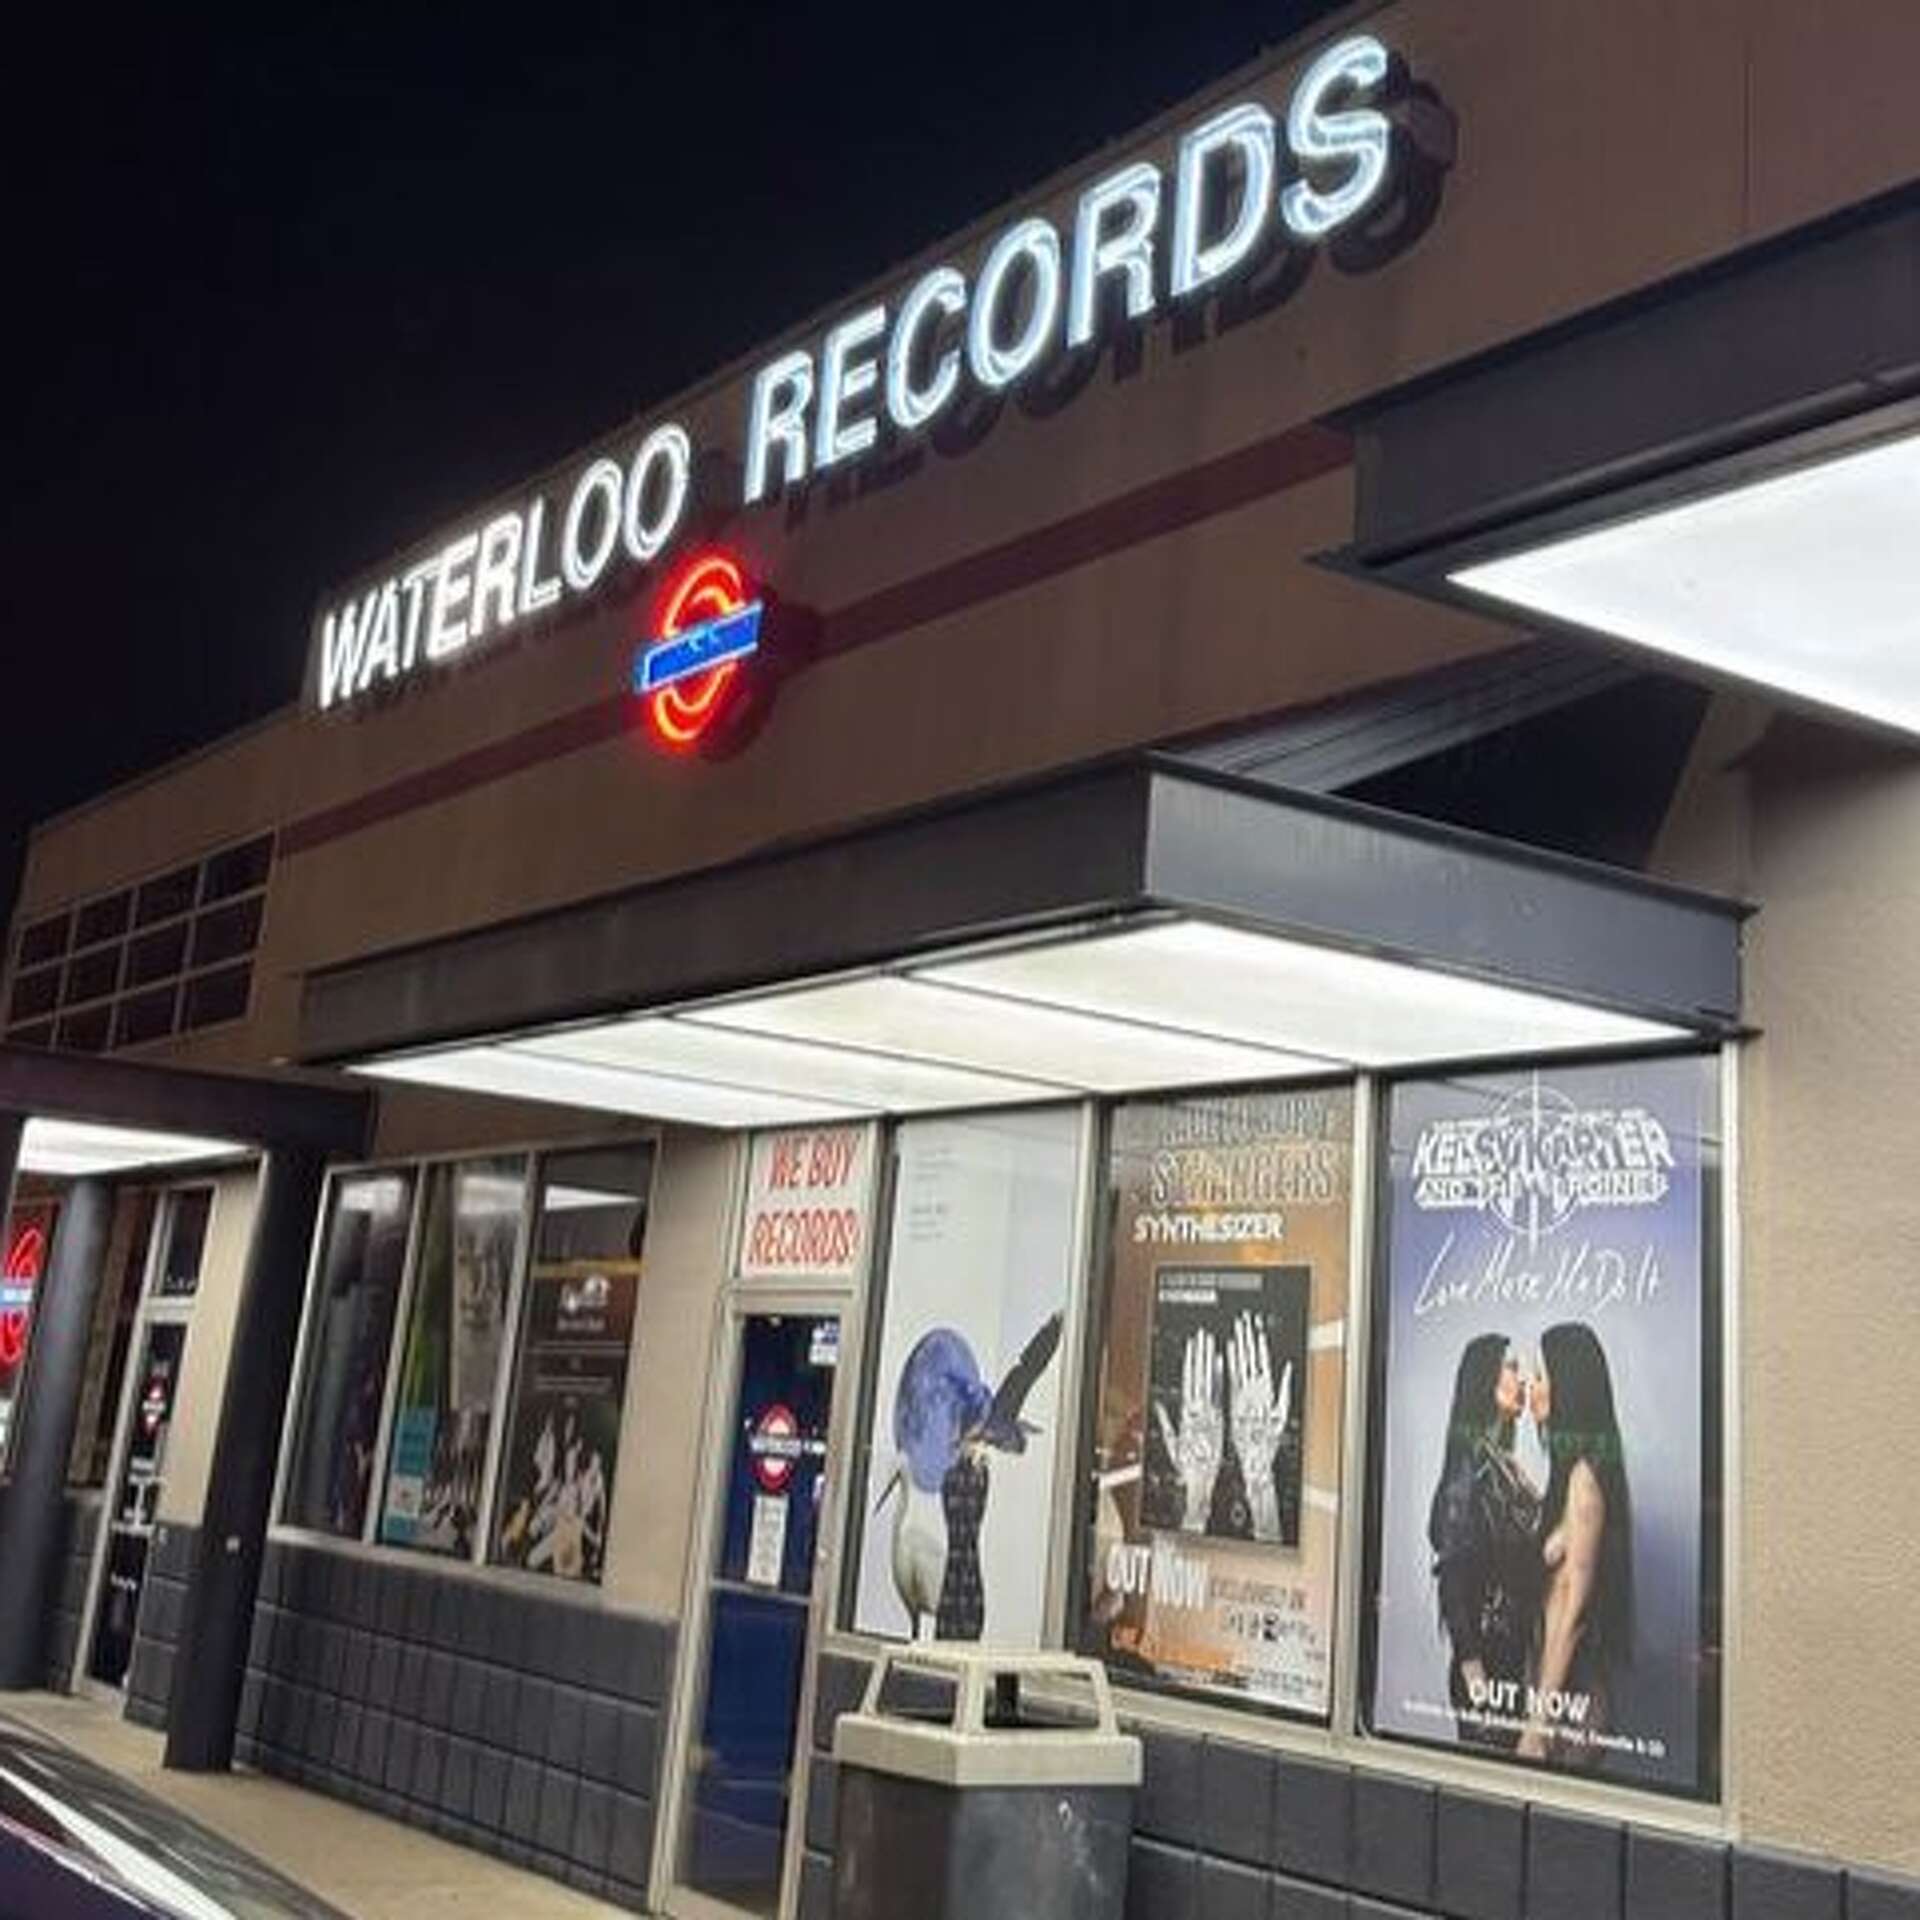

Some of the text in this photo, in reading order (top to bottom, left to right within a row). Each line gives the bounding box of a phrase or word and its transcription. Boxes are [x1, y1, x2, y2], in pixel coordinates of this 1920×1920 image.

[315, 35, 1390, 711] WATERLOO RECORDS
[768, 1134, 807, 1190] WE
[808, 1128, 860, 1188] BUY
[1107, 1542, 1150, 1595] OUT
[1151, 1536, 1209, 1611] NOW
[1469, 1677, 1519, 1709] OUT
[1526, 1686, 1590, 1722] NOW
